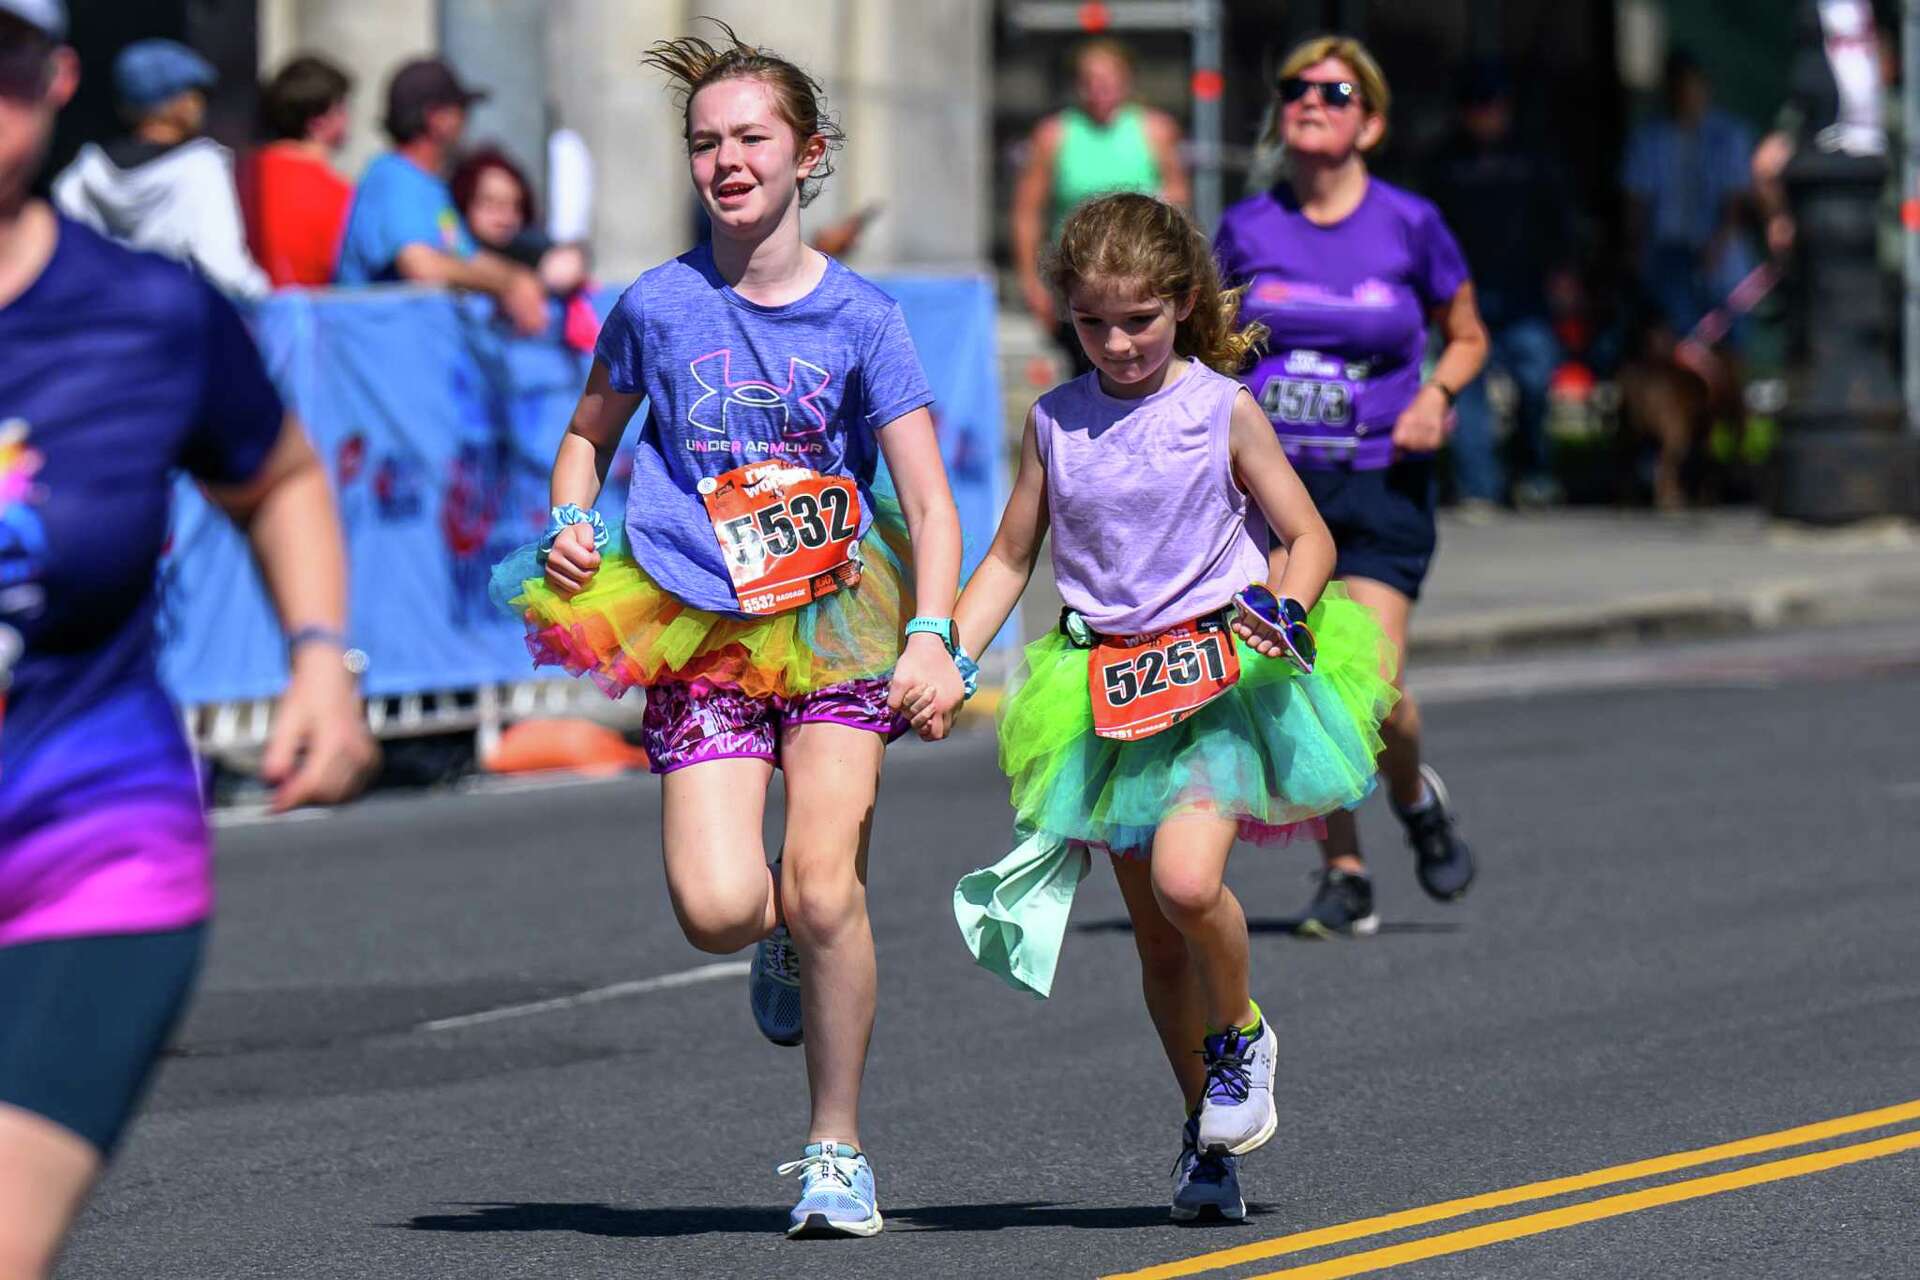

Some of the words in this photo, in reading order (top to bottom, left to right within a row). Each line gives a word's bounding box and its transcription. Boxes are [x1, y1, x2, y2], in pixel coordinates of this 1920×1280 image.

[686, 439, 741, 454] UNDER
[721, 486, 855, 567] 5532
[742, 592, 776, 614] 5532
[1103, 637, 1226, 707] 5251
